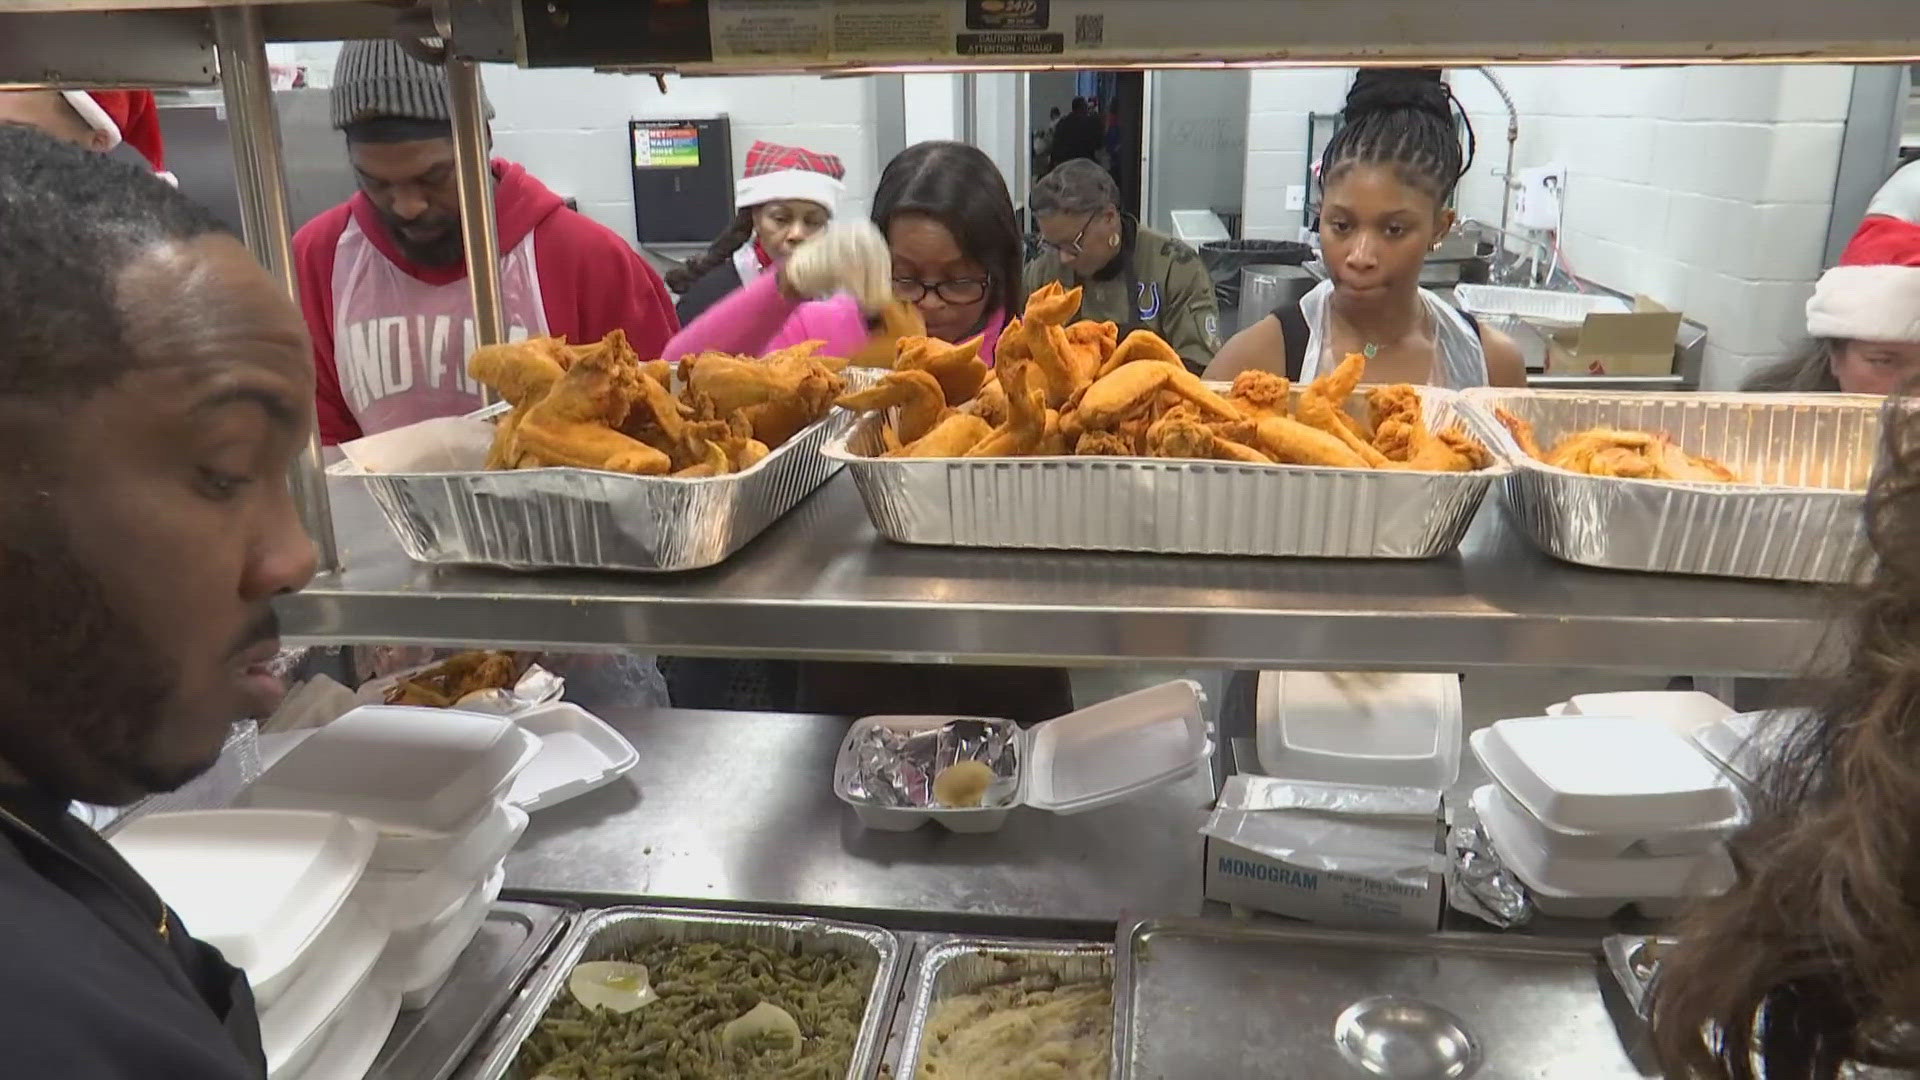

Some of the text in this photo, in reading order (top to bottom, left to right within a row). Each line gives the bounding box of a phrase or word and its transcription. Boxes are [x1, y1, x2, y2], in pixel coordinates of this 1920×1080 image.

[979, 34, 1016, 43] CAUTION
[968, 44, 1015, 53] ATTENTION
[650, 139, 673, 147] WASH
[1218, 856, 1318, 890] MONOGRAM
